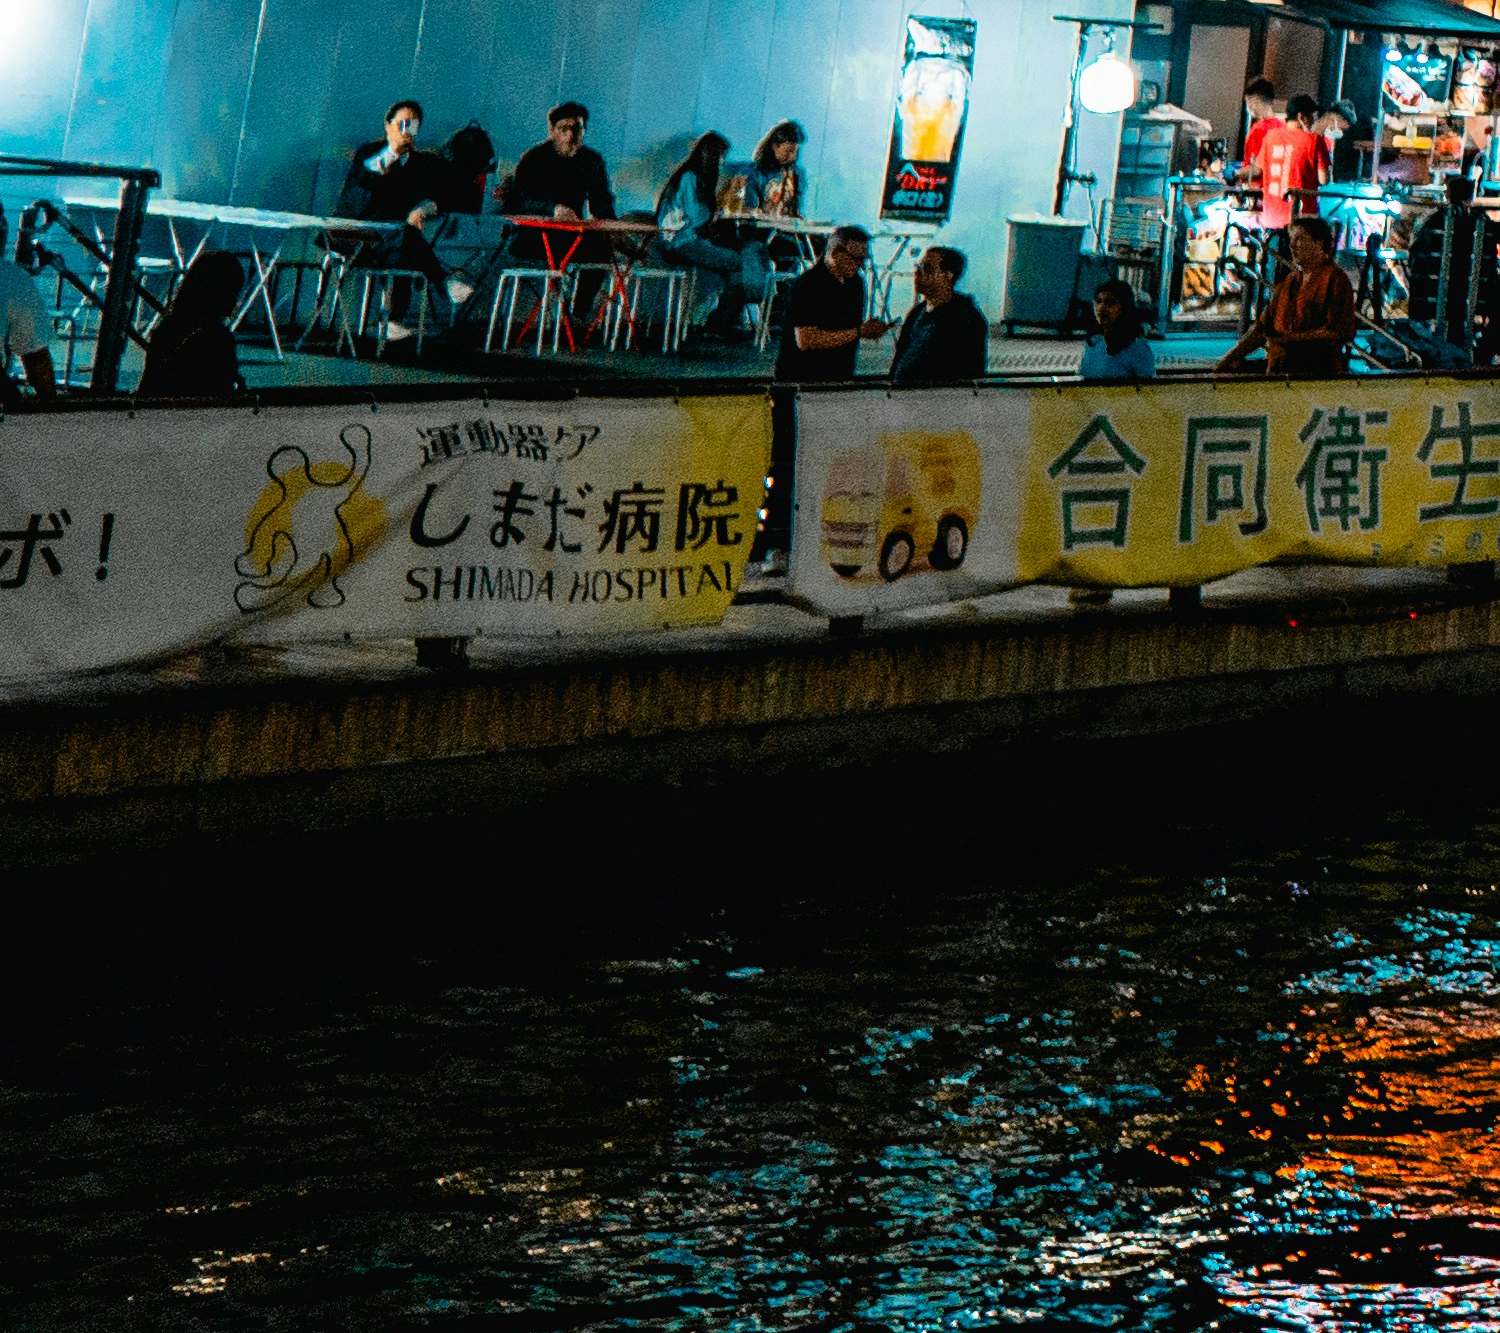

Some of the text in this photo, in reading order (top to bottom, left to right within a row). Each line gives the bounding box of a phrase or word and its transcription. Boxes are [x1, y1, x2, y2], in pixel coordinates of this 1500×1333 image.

[416, 419, 602, 469] 運動器ケア
[408, 479, 743, 555] しまだ病院
[404, 559, 739, 605] SHIMADA HOSPITAL
